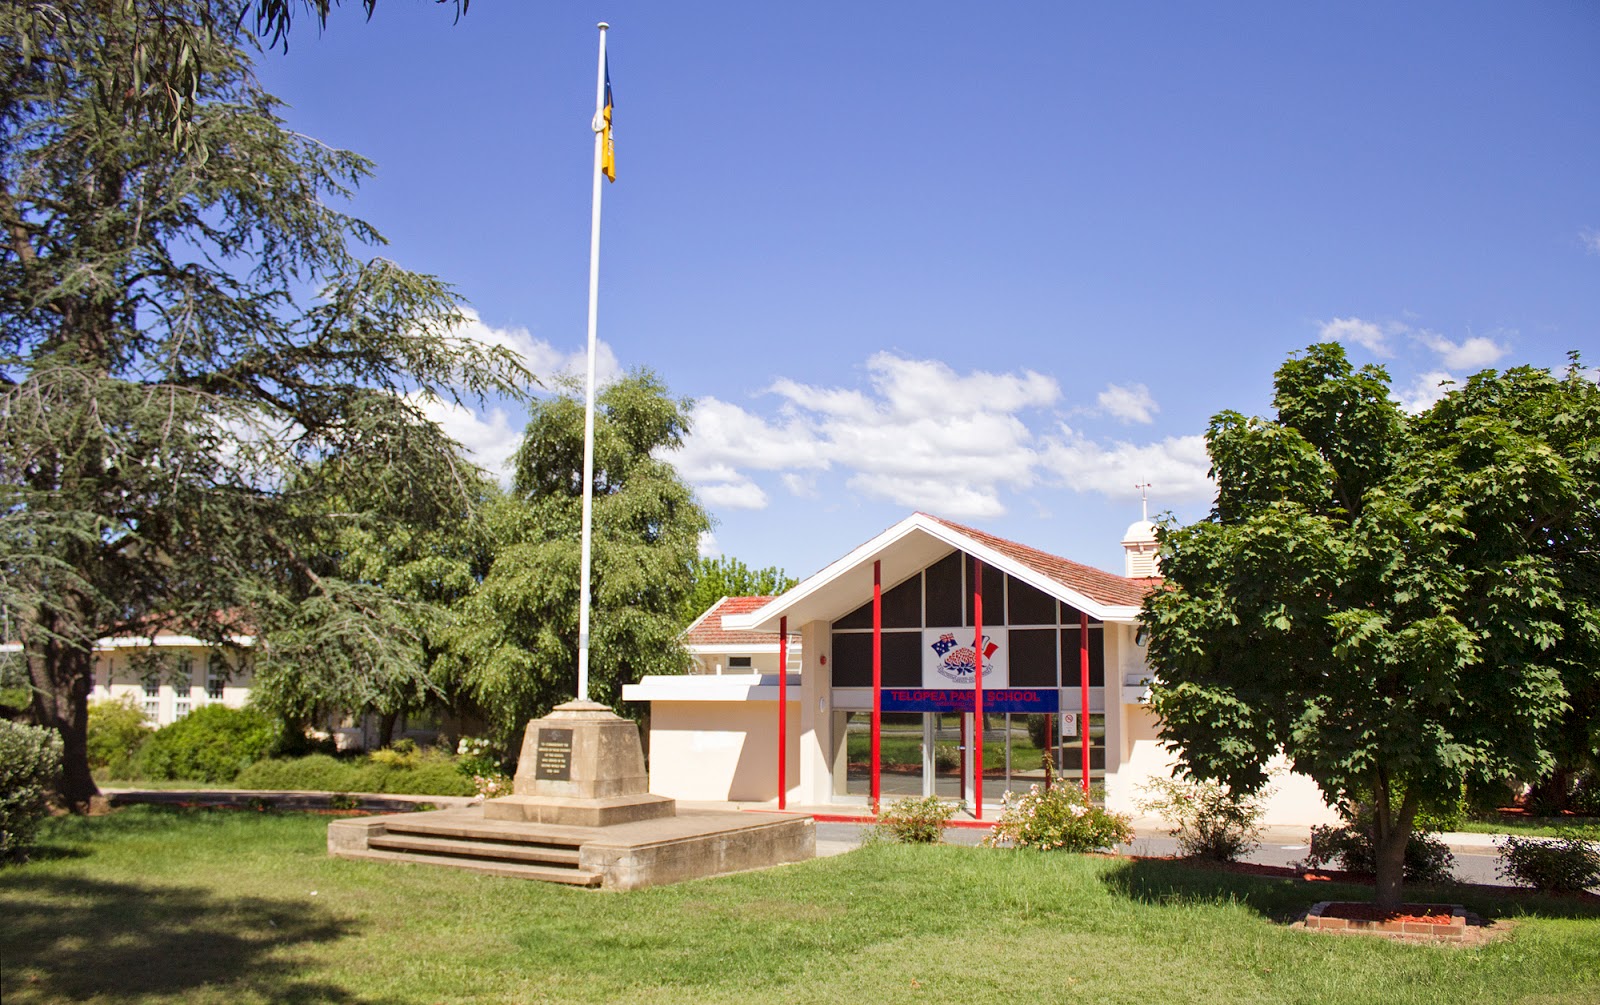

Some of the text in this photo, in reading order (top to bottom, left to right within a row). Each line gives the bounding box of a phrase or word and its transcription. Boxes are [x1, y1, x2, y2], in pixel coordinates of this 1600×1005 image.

[891, 691, 1040, 702] TELOPEA PAR SCHOOL
